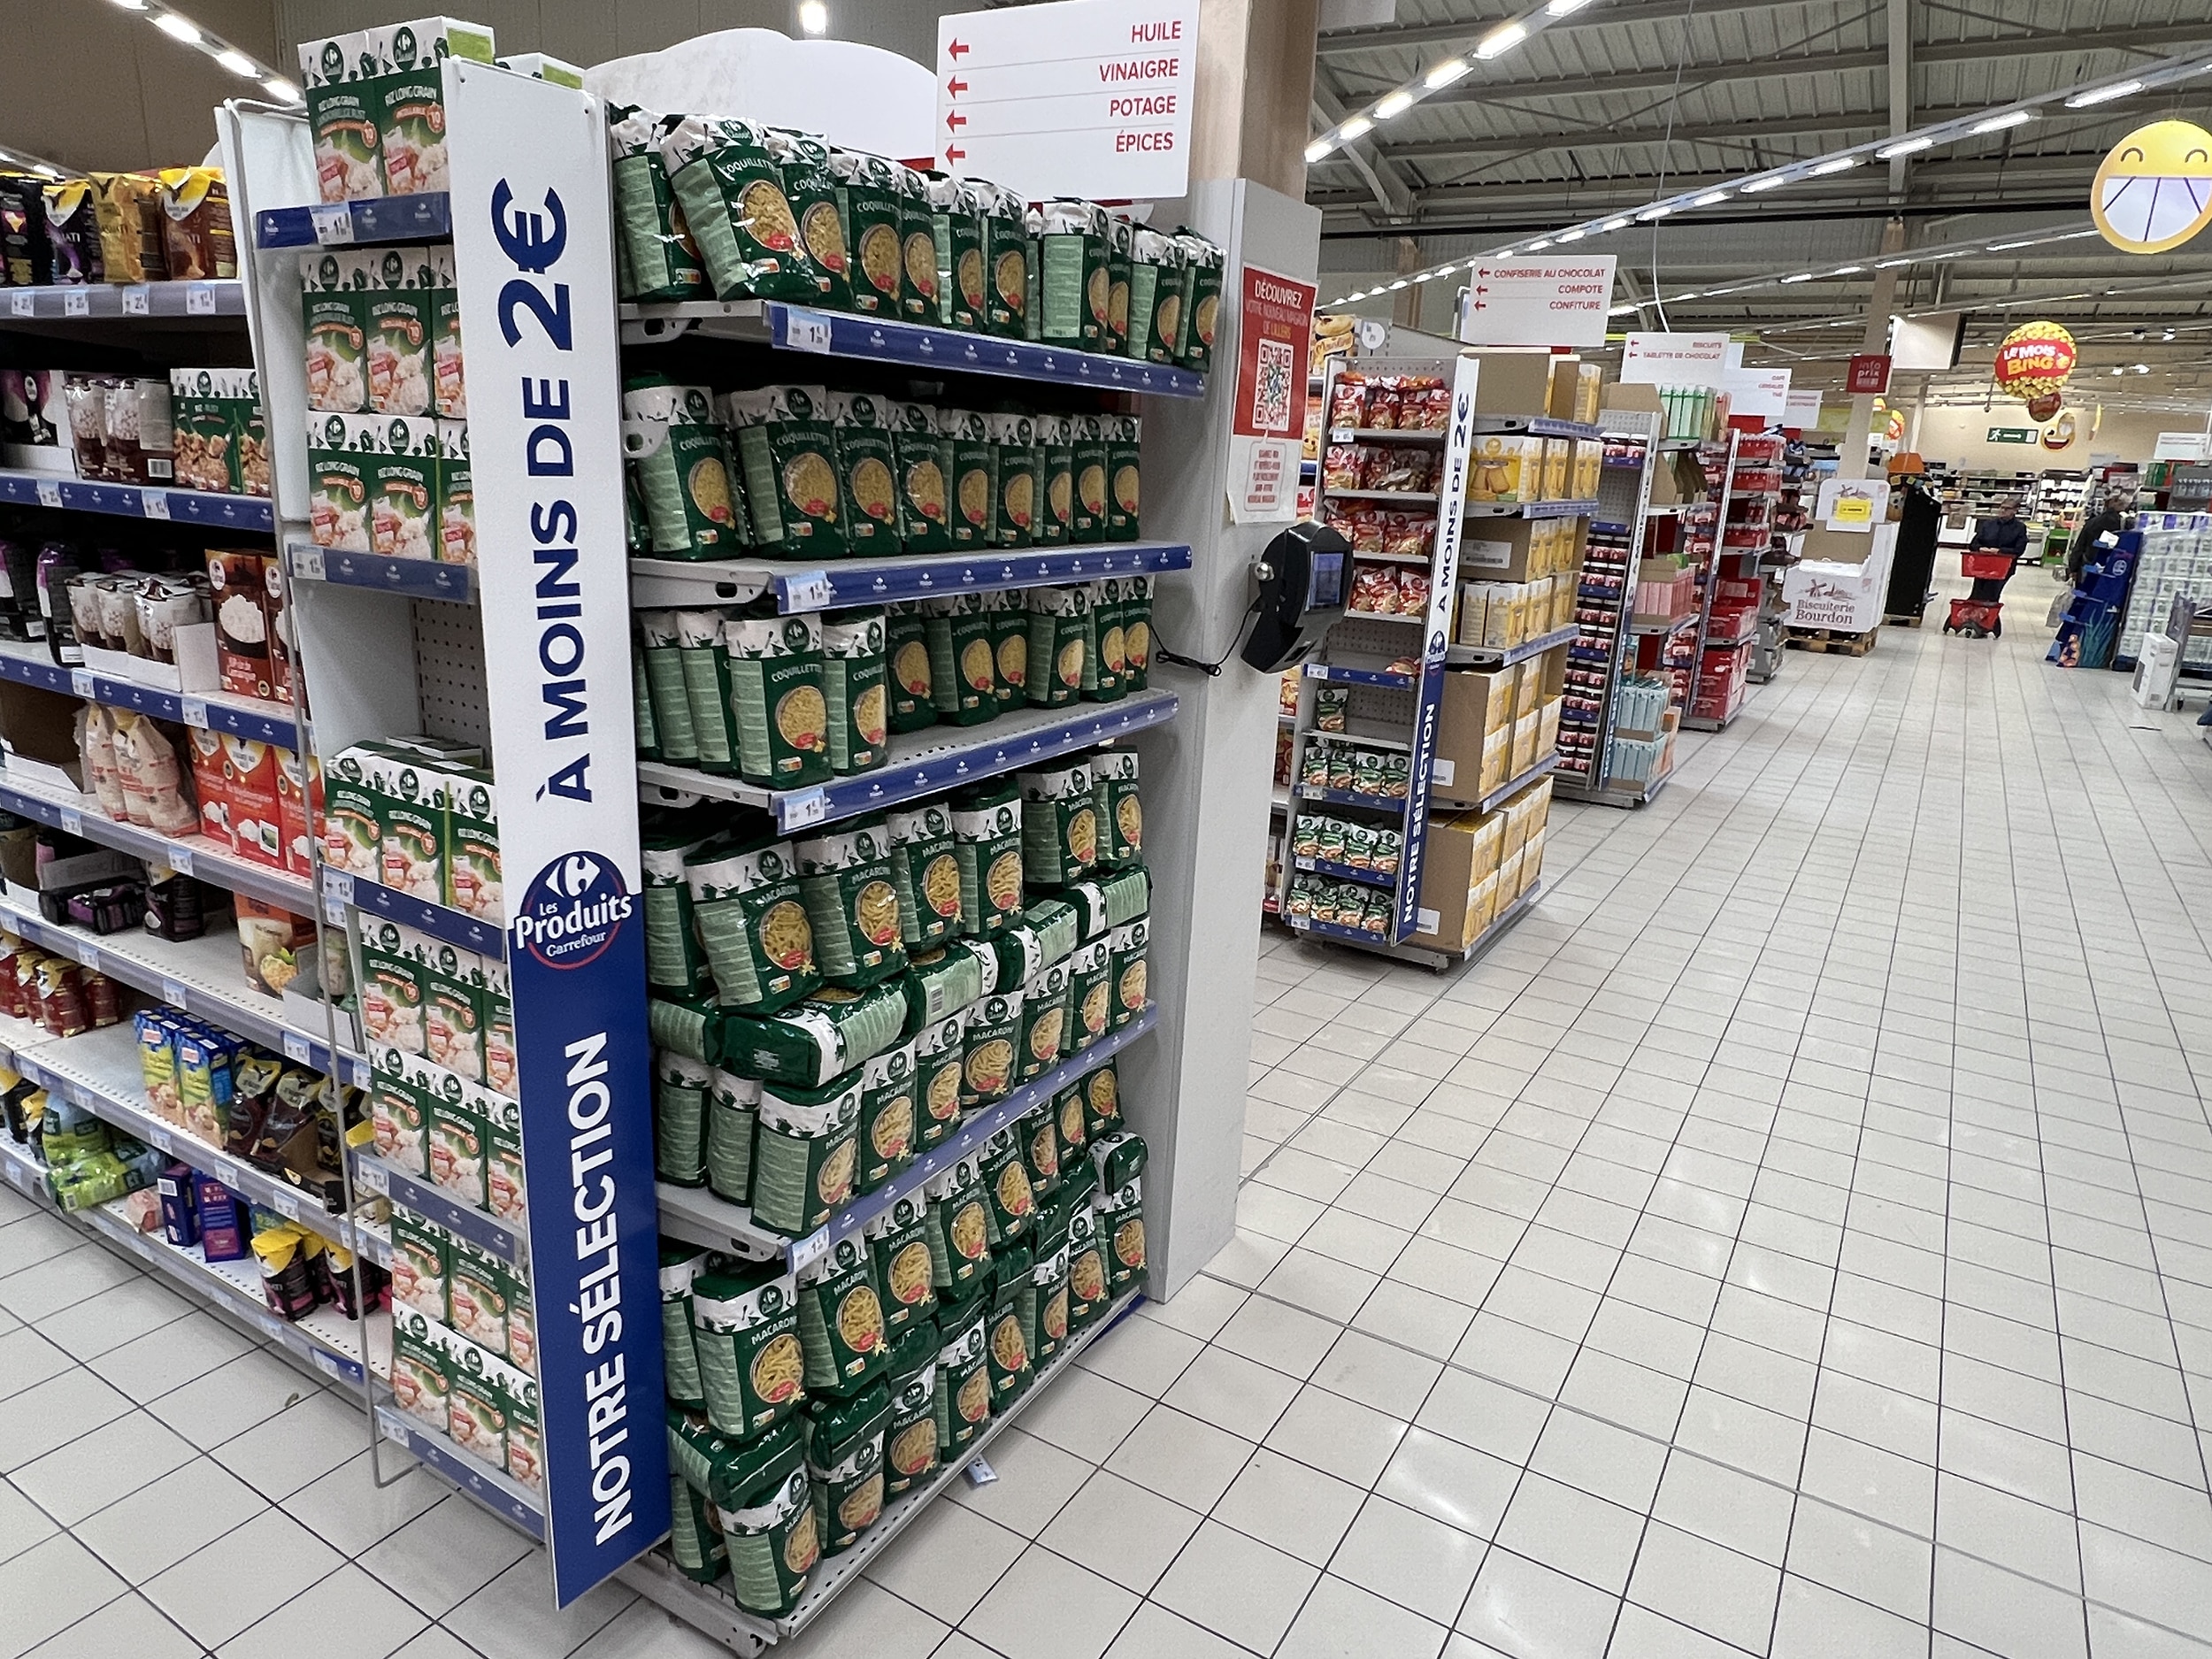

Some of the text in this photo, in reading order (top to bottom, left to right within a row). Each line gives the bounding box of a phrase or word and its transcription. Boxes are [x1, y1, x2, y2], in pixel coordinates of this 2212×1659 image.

[1131, 20, 1182, 42] HUILE
[1099, 58, 1179, 82] VINAIGRE
[1110, 96, 1177, 117] POTAGE
[1115, 129, 1174, 153] ÉPICES
[491, 177, 573, 350] 2€
[1494, 268, 1606, 279] CONFISERIE AU CHOCOLAT
[1255, 277, 1303, 310] DÉCOUVREZ
[1558, 285, 1603, 295] COMPOTE
[1549, 301, 1601, 311] CONFITURE
[2003, 344, 2056, 360] LE MOIS
[1857, 368, 1880, 379] prix
[1858, 359, 1881, 372] info
[522, 376, 574, 477] DE
[1451, 457, 1463, 493] DE
[1440, 500, 1458, 588] MOINS
[1795, 610, 1854, 625] Bourdon
[1796, 599, 1855, 613] Biscuiterie
[531, 499, 589, 741] MOINS
[536, 752, 593, 803] À
[1412, 703, 1436, 836] SÉLECTION
[1403, 841, 1420, 923] NOTRE
[516, 893, 632, 949] Produits
[539, 902, 557, 917] Les
[546, 932, 607, 956] Carrefour
[565, 1032, 622, 1355] SÉLECTION
[587, 1353, 633, 1546] NOTRE
